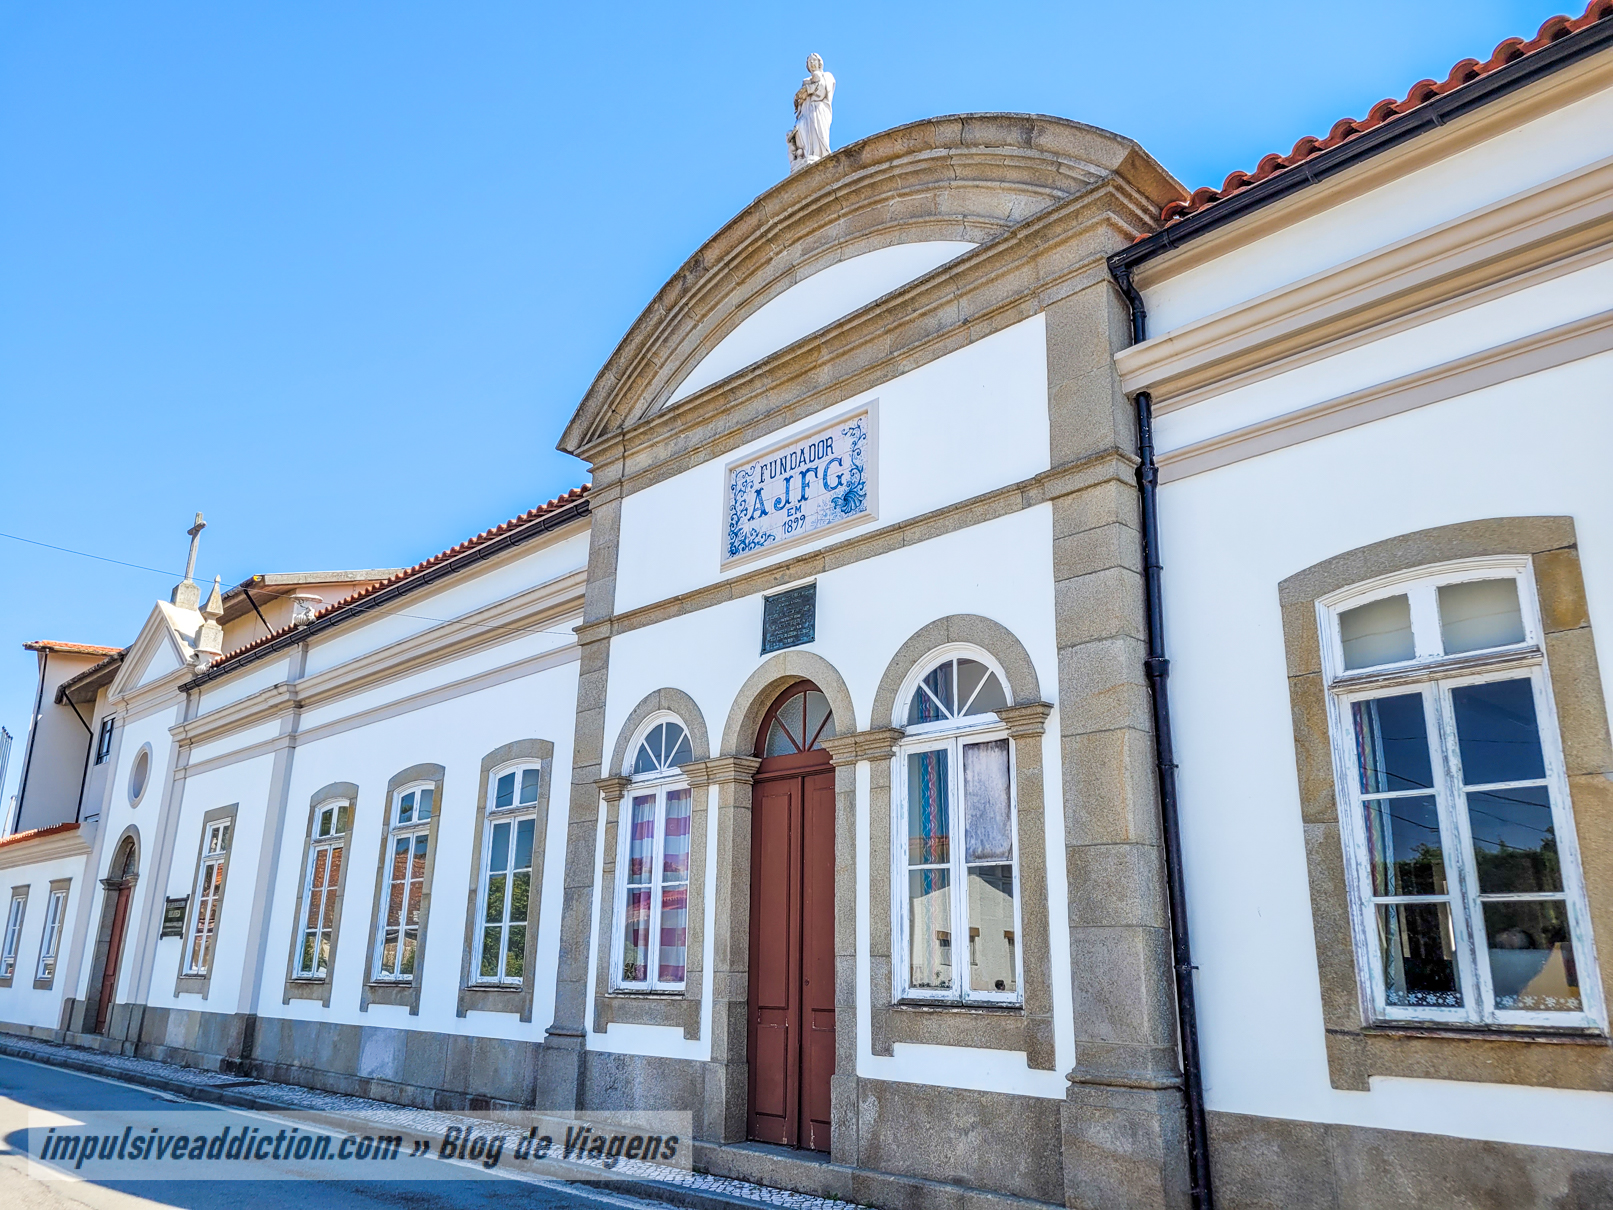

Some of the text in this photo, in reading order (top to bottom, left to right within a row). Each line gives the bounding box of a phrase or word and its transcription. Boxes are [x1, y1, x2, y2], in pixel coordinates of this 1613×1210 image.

[758, 437, 834, 484] FUNDADOR
[786, 504, 802, 517] EM
[782, 514, 806, 534] 1899
